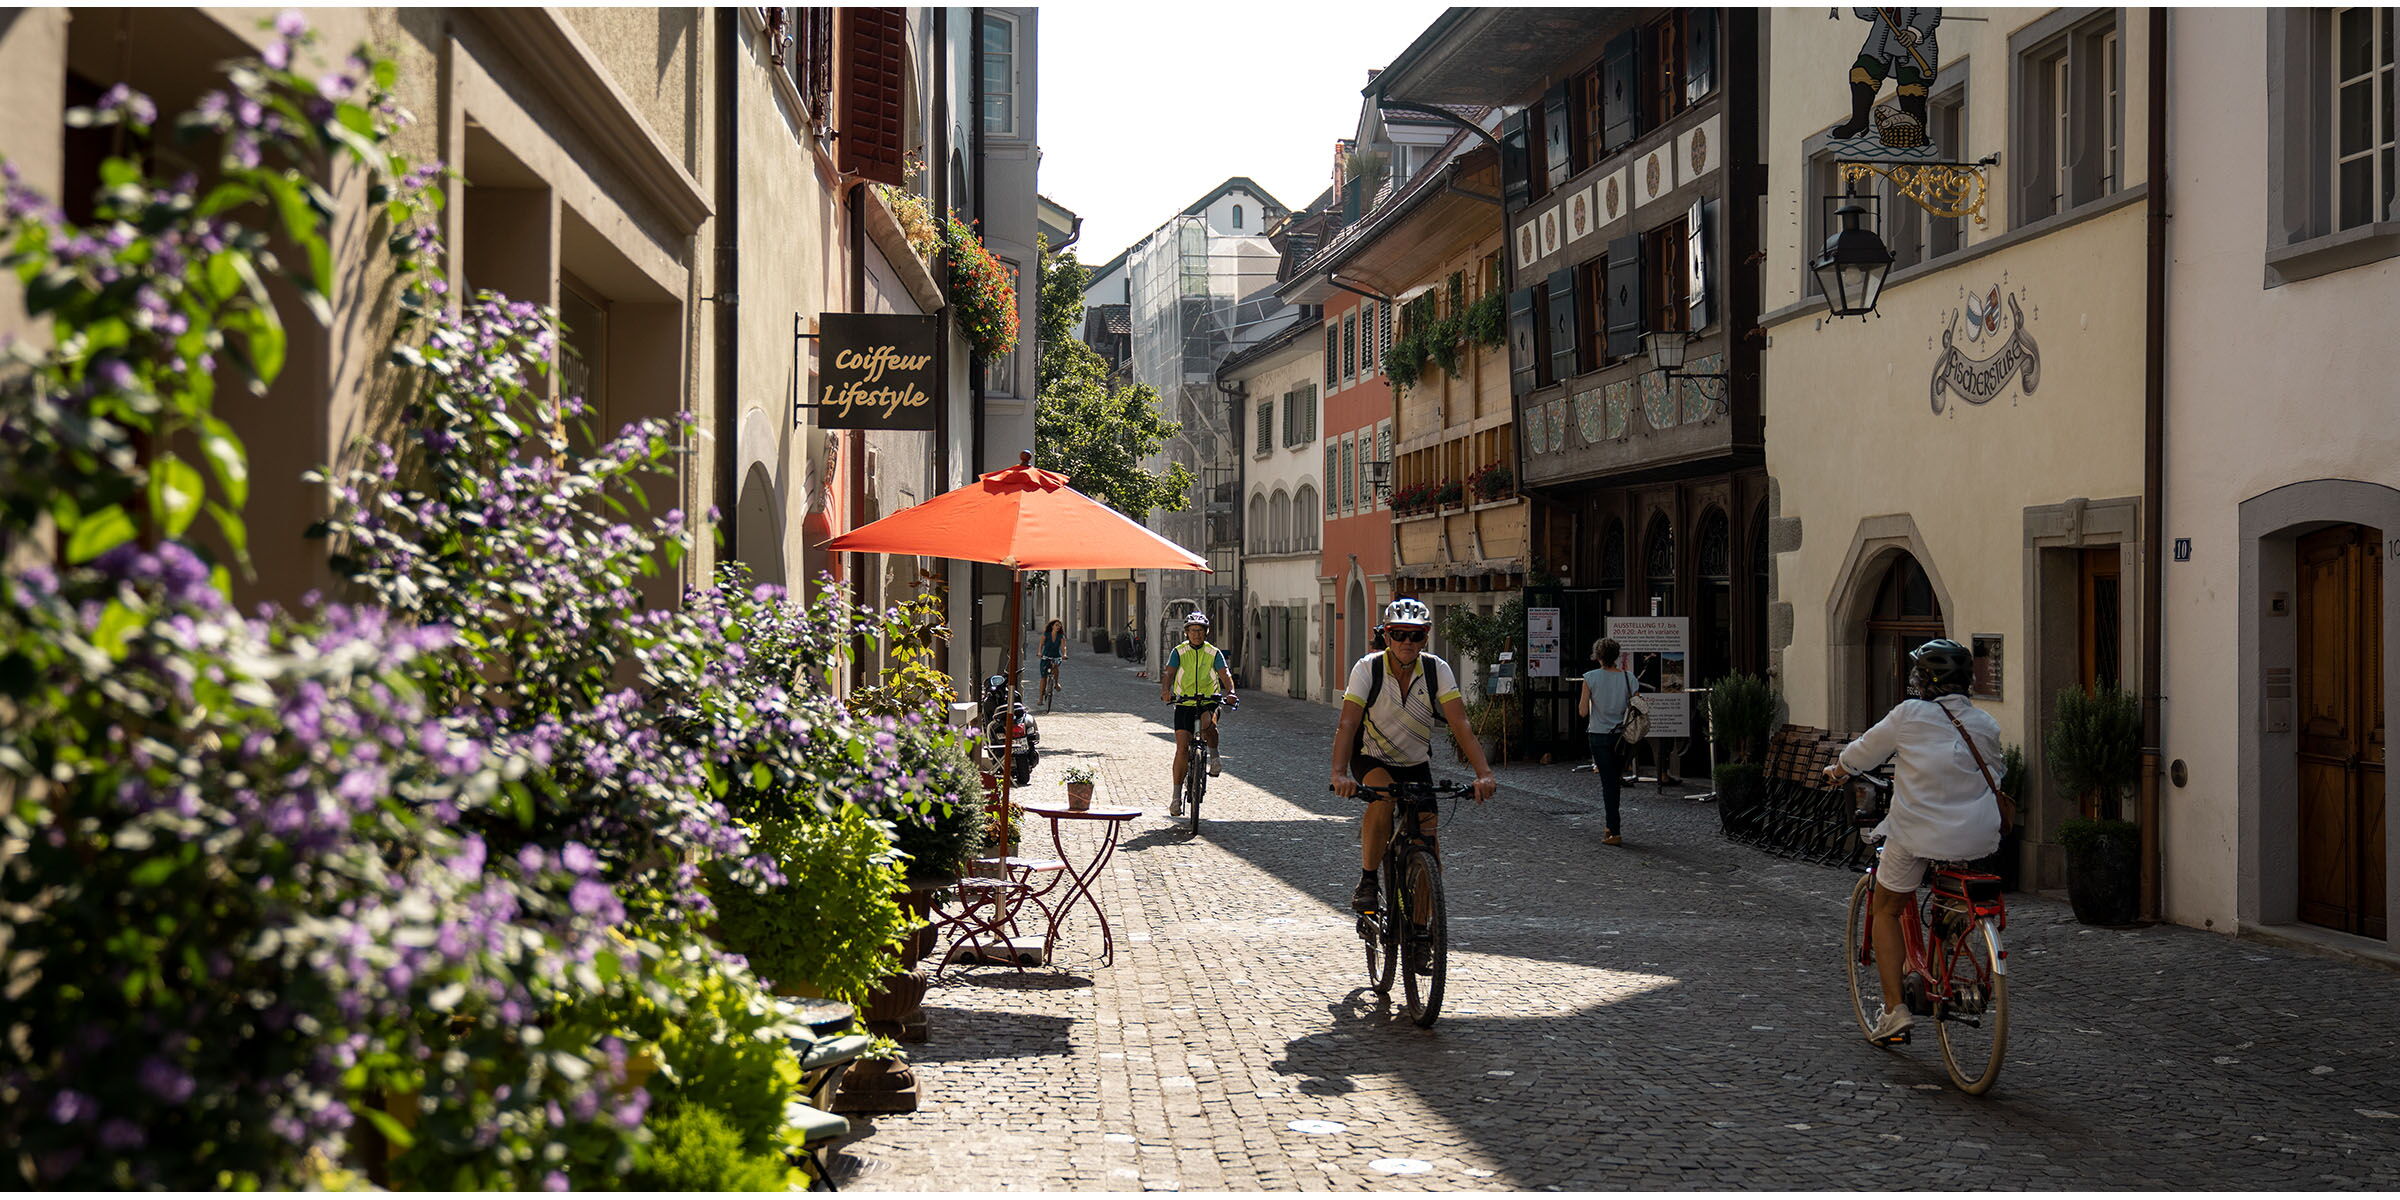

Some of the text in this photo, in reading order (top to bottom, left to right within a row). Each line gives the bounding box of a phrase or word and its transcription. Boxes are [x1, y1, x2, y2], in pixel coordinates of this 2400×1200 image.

[835, 345, 931, 383] Coiffeur
[821, 381, 930, 419] Lifestyle
[2176, 540, 2188, 559] 10
